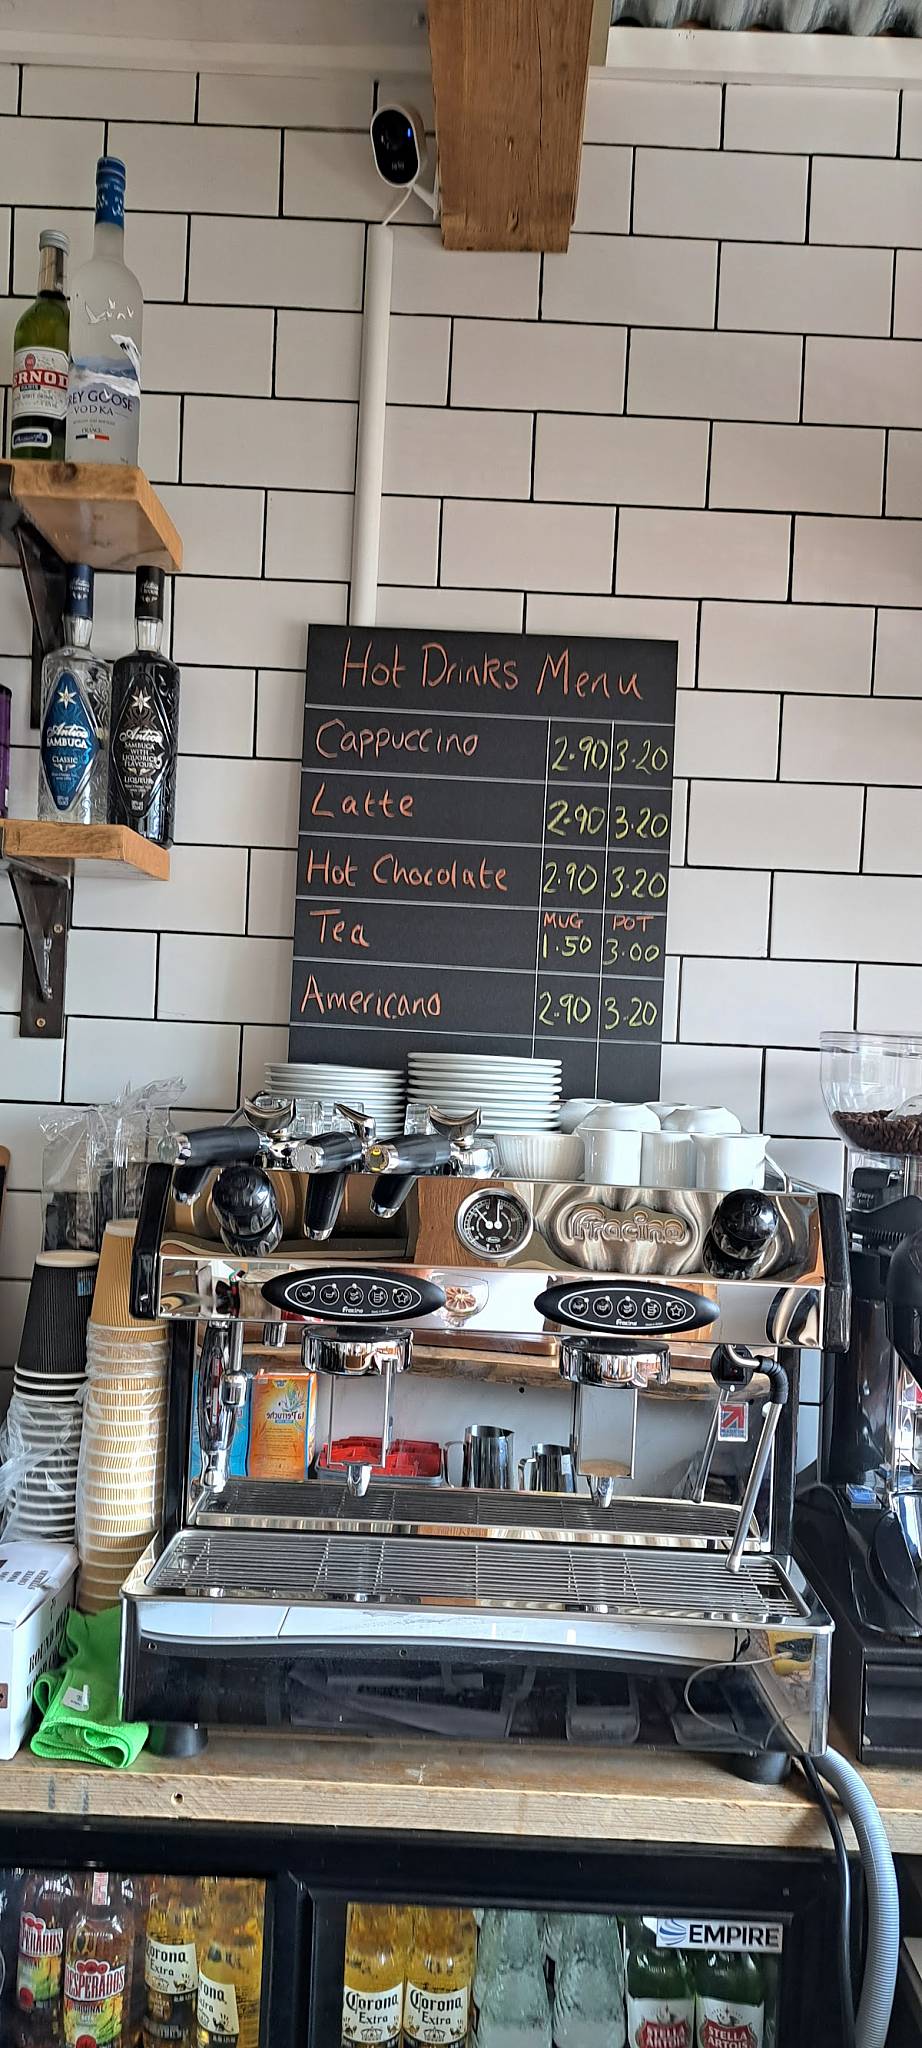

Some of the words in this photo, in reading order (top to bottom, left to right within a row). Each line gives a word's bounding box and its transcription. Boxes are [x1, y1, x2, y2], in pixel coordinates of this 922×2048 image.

[74, 404, 114, 416] VODKA
[88, 390, 133, 412] GOOSE
[341, 638, 407, 688] Hot
[421, 641, 519, 690] Drinks
[536, 649, 644, 701] Menu
[124, 742, 155, 750] SAMBUCA
[130, 749, 149, 758] WITH
[316, 718, 479, 759] Cappuccino
[551, 736, 609, 772] 2.90
[613, 738, 668, 775] 3.20
[52, 755, 78, 764] CLASSIC
[310, 781, 415, 818] Latte
[548, 800, 605, 837] 2.90
[614, 806, 669, 840] 3.20
[306, 849, 358, 887] Hot
[372, 853, 508, 891] Chocolate
[543, 861, 597, 896] 2.90
[610, 866, 667, 898] 3.20
[543, 912, 584, 930] MUG
[612, 914, 655, 932] POT
[309, 908, 370, 947] Tea
[541, 935, 592, 960] 1.50
[603, 938, 660, 965] 3.00
[300, 974, 441, 1019] Americano
[538, 991, 592, 1026] 2.90
[604, 996, 657, 1030] 3.20
[689, 1924, 780, 1948] EMPIRE
[146, 1941, 186, 1963] Corona
[151, 1959, 174, 1976] Extra
[200, 1980, 225, 2001] rona
[410, 1989, 462, 2013] Corona
[345, 1991, 399, 2014] Corona
[359, 2011, 388, 2025] Extra
[422, 2011, 451, 2026] Extra
[646, 2025, 686, 2038] STELLA
[707, 2025, 748, 2040] STELLA
[707, 2037, 748, 2048] ARTOIS
